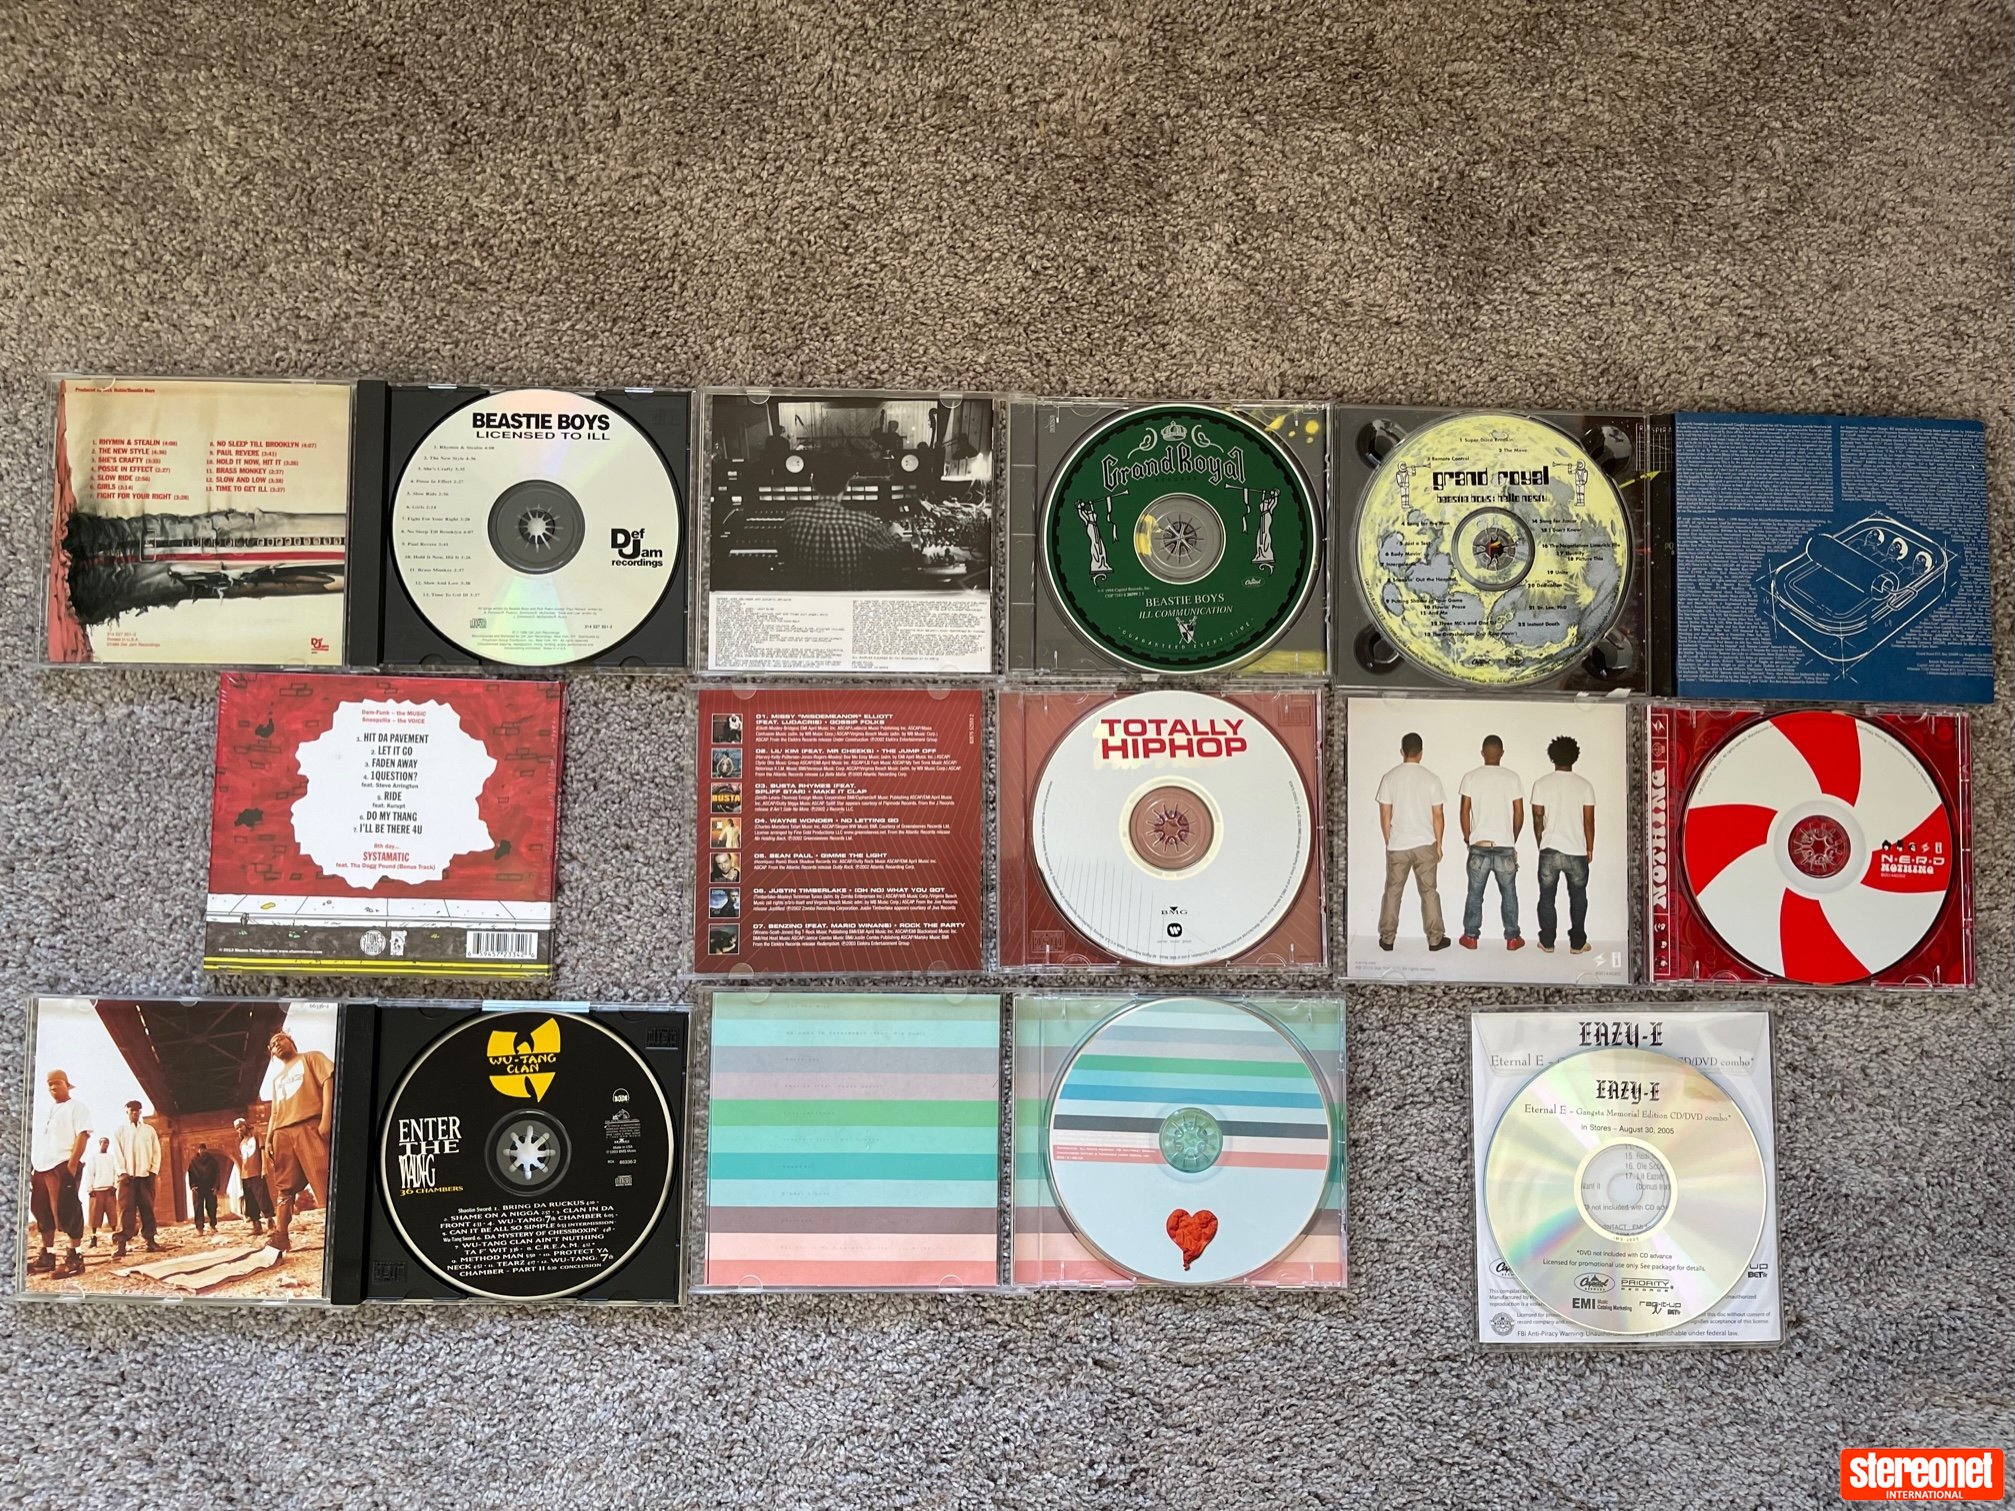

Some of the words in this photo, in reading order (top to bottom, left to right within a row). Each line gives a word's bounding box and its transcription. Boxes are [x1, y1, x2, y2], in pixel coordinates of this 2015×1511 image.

[472, 412, 553, 429] BEASTIE
[557, 414, 610, 431] BOYS
[476, 431, 555, 440] LICENSED
[561, 432, 582, 440] TO
[99, 438, 125, 446] RHYMIN
[1101, 445, 1175, 492] Grand
[1176, 441, 1246, 486] Royal
[1432, 467, 1488, 491] grand
[1498, 465, 1549, 485] royal
[611, 528, 645, 549] Def
[618, 539, 663, 560] Jam
[611, 558, 663, 568] recordings
[1145, 596, 1192, 607] BEASTIE
[1194, 593, 1225, 603] BOYS
[1139, 610, 1154, 620] ILL
[1154, 605, 1233, 618] COMMUNICATION
[1101, 719, 1244, 736] TOTALLY
[363, 732, 376, 742] HIT
[378, 733, 388, 743] DA
[390, 733, 429, 744] PAVEMENT
[378, 745, 391, 756] LET
[393, 745, 401, 756] IT
[402, 746, 413, 756] GO
[1101, 737, 1247, 759] HIPHOP
[372, 758, 395, 768] FADEN
[397, 758, 418, 769] AWAY
[370, 770, 418, 781] 1QUESTION?
[384, 791, 402, 801] RIDE
[712, 794, 740, 802] BUSTA
[366, 811, 377, 821] DO
[379, 811, 391, 821] MY
[393, 811, 417, 822] THANG
[359, 823, 373, 833] I'LL
[375, 824, 385, 833] BE
[387, 824, 410, 834] THERE
[412, 825, 423, 835] 4U
[1651, 766, 1666, 909] NOTHING
[363, 851, 410, 862] SYSTAMATIC
[1881, 863, 1934, 875] NOTHING
[1578, 1021, 1663, 1048] EAZY-E
[489, 1053, 557, 1065] WU-TANG
[1491, 1053, 1531, 1067] Eternal
[1536, 1055, 1544, 1066] E
[506, 1063, 539, 1074] CLAN
[1596, 1080, 1660, 1104] EAZY-E
[1524, 1104, 1556, 1114] Eternal
[1560, 1106, 1567, 1115] E
[1576, 1108, 1604, 1117] Gangsta
[1606, 1109, 1640, 1118] Memorial
[1642, 1110, 1668, 1119] Edition
[1670, 1112, 1703, 1121] CD/DVD
[398, 1116, 462, 1142] ENTER
[1590, 1124, 1612, 1132] Stores
[1618, 1125, 1643, 1134] August
[399, 1139, 459, 1155] THE
[400, 1188, 414, 1197] 36
[415, 1186, 464, 1194] CHAMBERS
[502, 1203, 531, 1211] BRING
[450, 1214, 483, 1222] SHAME
[563, 1206, 587, 1214] CLAN
[558, 1213, 601, 1221] CHAMBER
[523, 1222, 555, 1230] SIMPLE
[462, 1240, 507, 1249] WU-TANG
[562, 1233, 605, 1242] NUTHING
[498, 1231, 534, 1239] MYSTERY
[460, 1254, 500, 1263] METHOD
[553, 1248, 594, 1256] PROTECT
[1603, 1250, 1626, 1258] included
[447, 1263, 472, 1271] NECK
[459, 1269, 504, 1277] CHAMBER
[560, 1262, 602, 1270] CONCLUSION
[1578, 1260, 1614, 1268] promotional
[1652, 1263, 1676, 1271] package
[1621, 1279, 1670, 1287] PRIORITY
[1572, 1297, 1596, 1309] EMI
